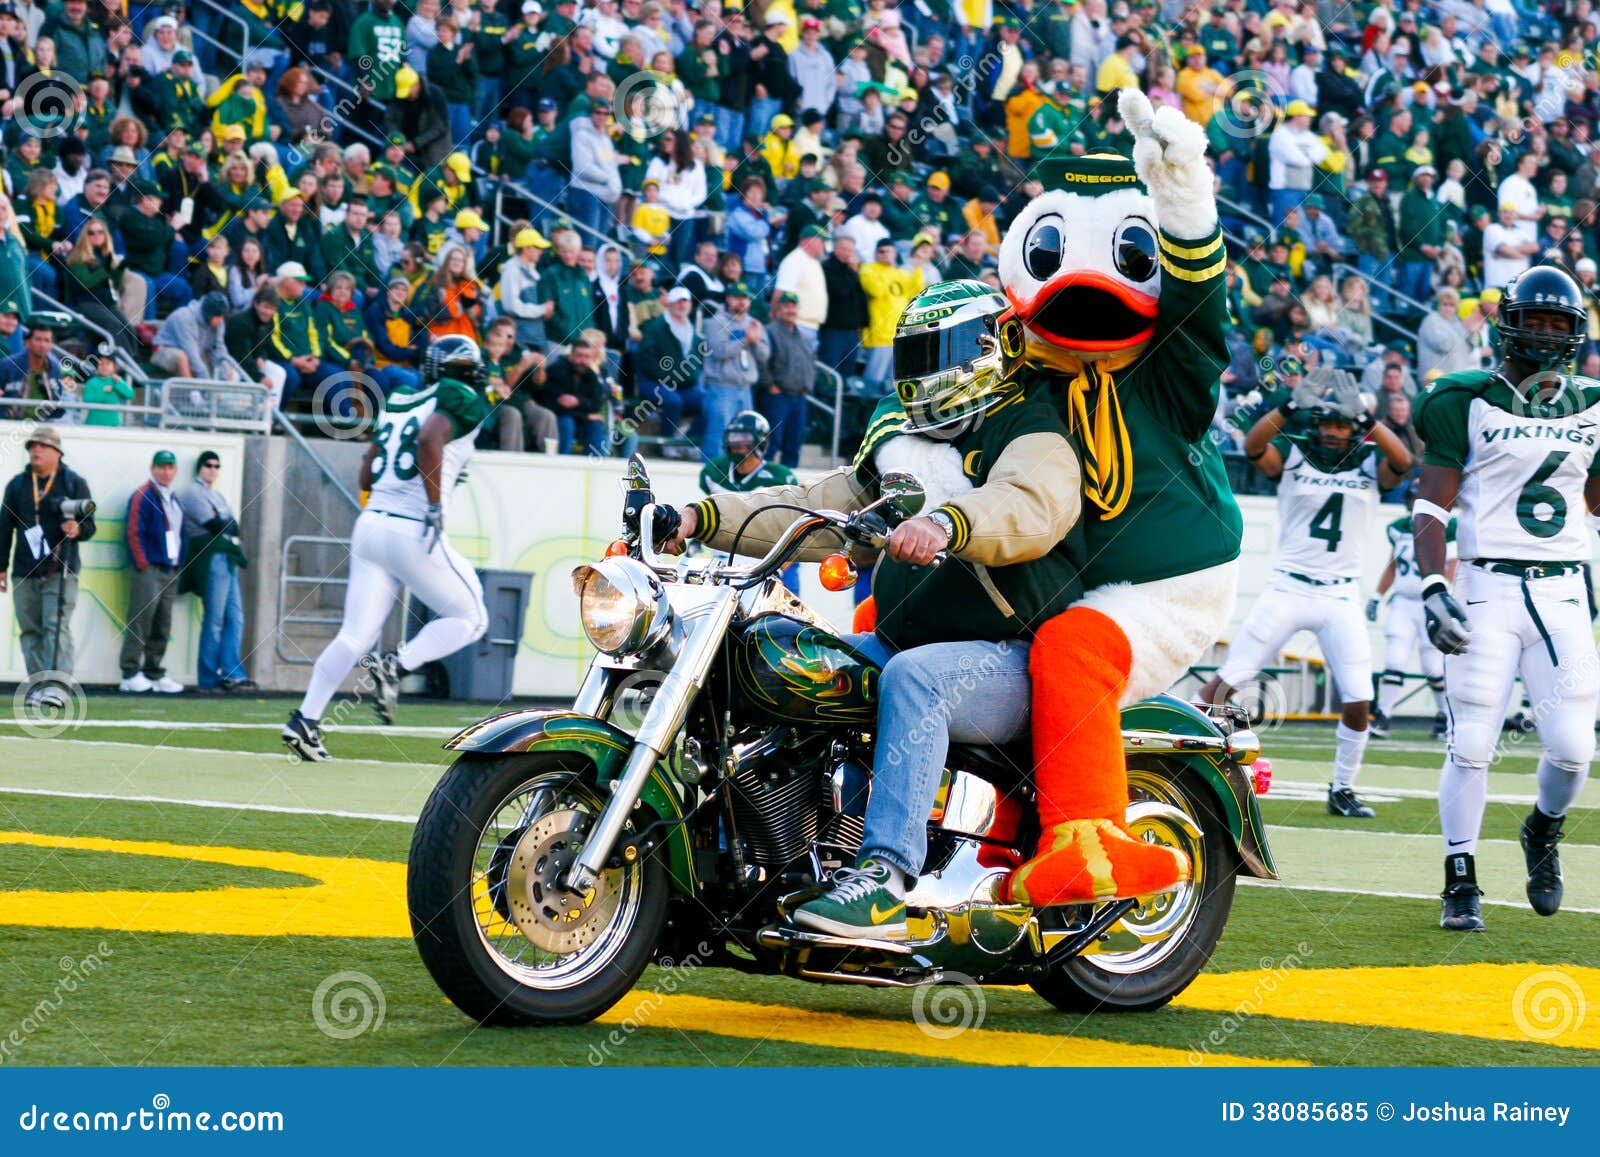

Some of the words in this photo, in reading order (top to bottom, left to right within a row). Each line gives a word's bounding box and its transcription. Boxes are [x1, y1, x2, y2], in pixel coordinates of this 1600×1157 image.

[1064, 172, 1137, 183] OREGON
[1482, 425, 1595, 447] VIKINGS
[1291, 472, 1371, 490] VIKINGS
[1516, 450, 1567, 538] 6
[1309, 492, 1344, 552] 4
